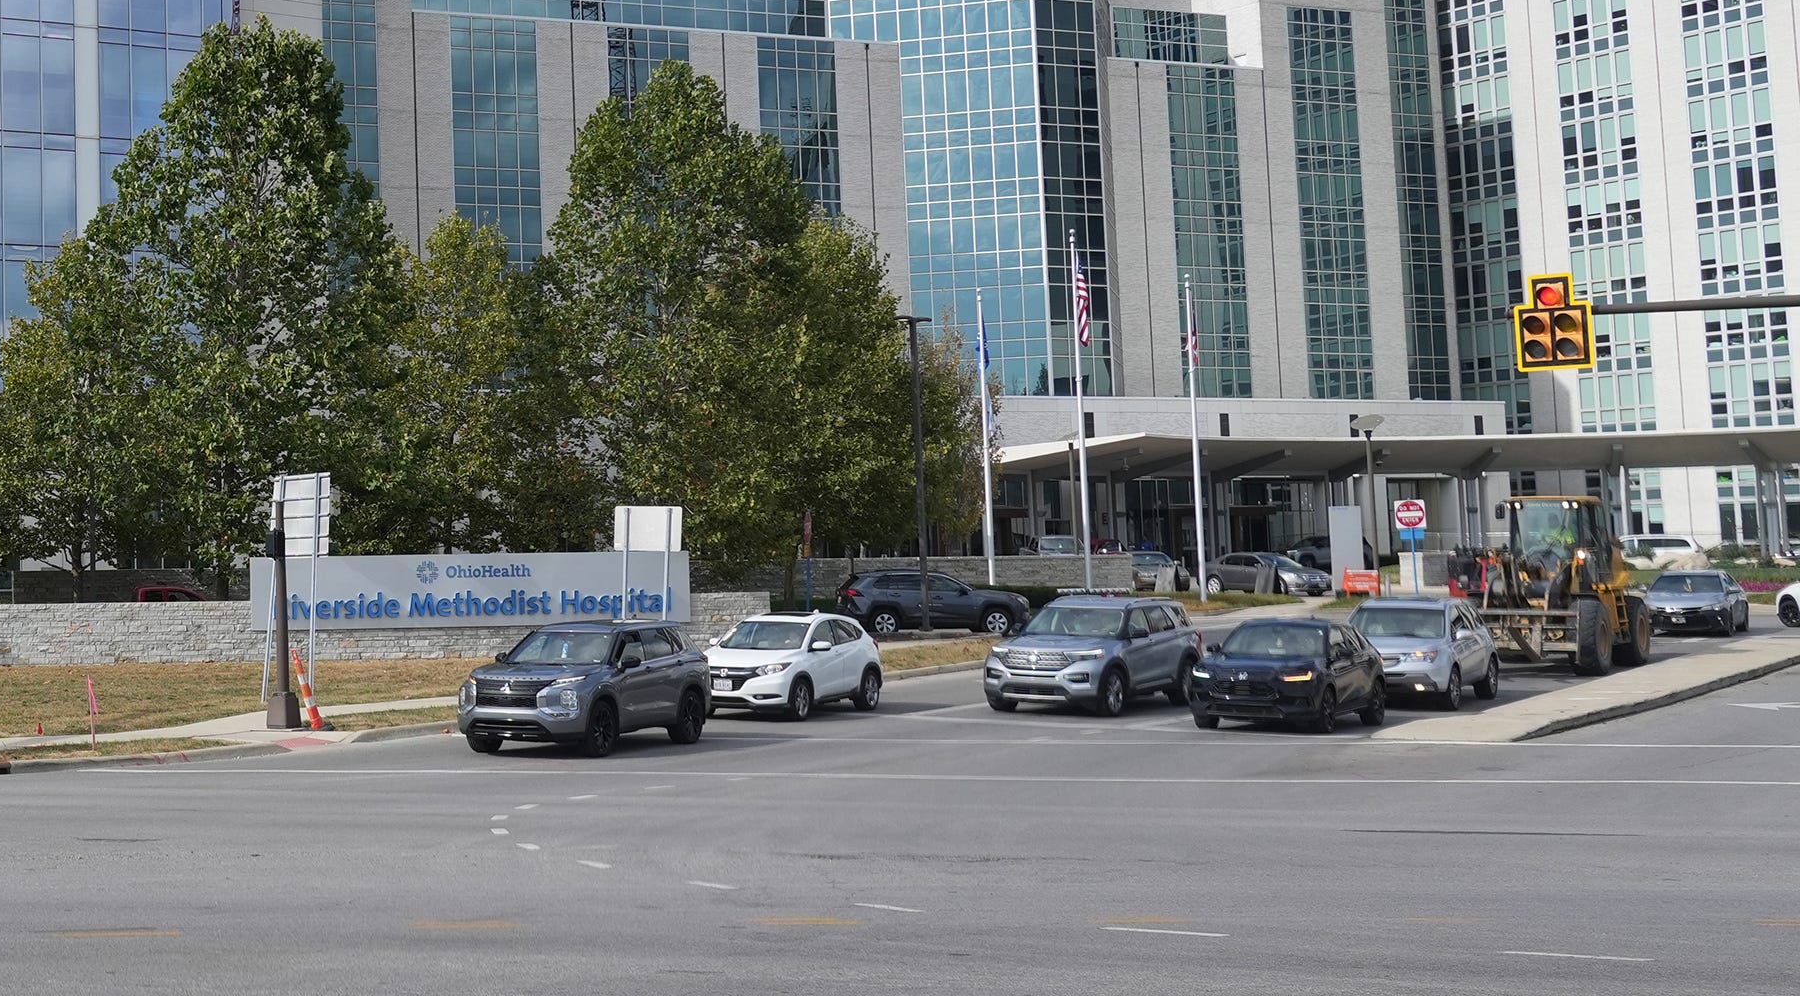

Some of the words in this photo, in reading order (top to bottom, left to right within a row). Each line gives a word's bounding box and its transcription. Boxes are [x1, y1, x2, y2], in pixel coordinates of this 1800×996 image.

[445, 563, 532, 578] OhioHealth
[273, 592, 400, 621] iverside
[407, 589, 551, 618] Methodist
[560, 586, 673, 618] Hospital
